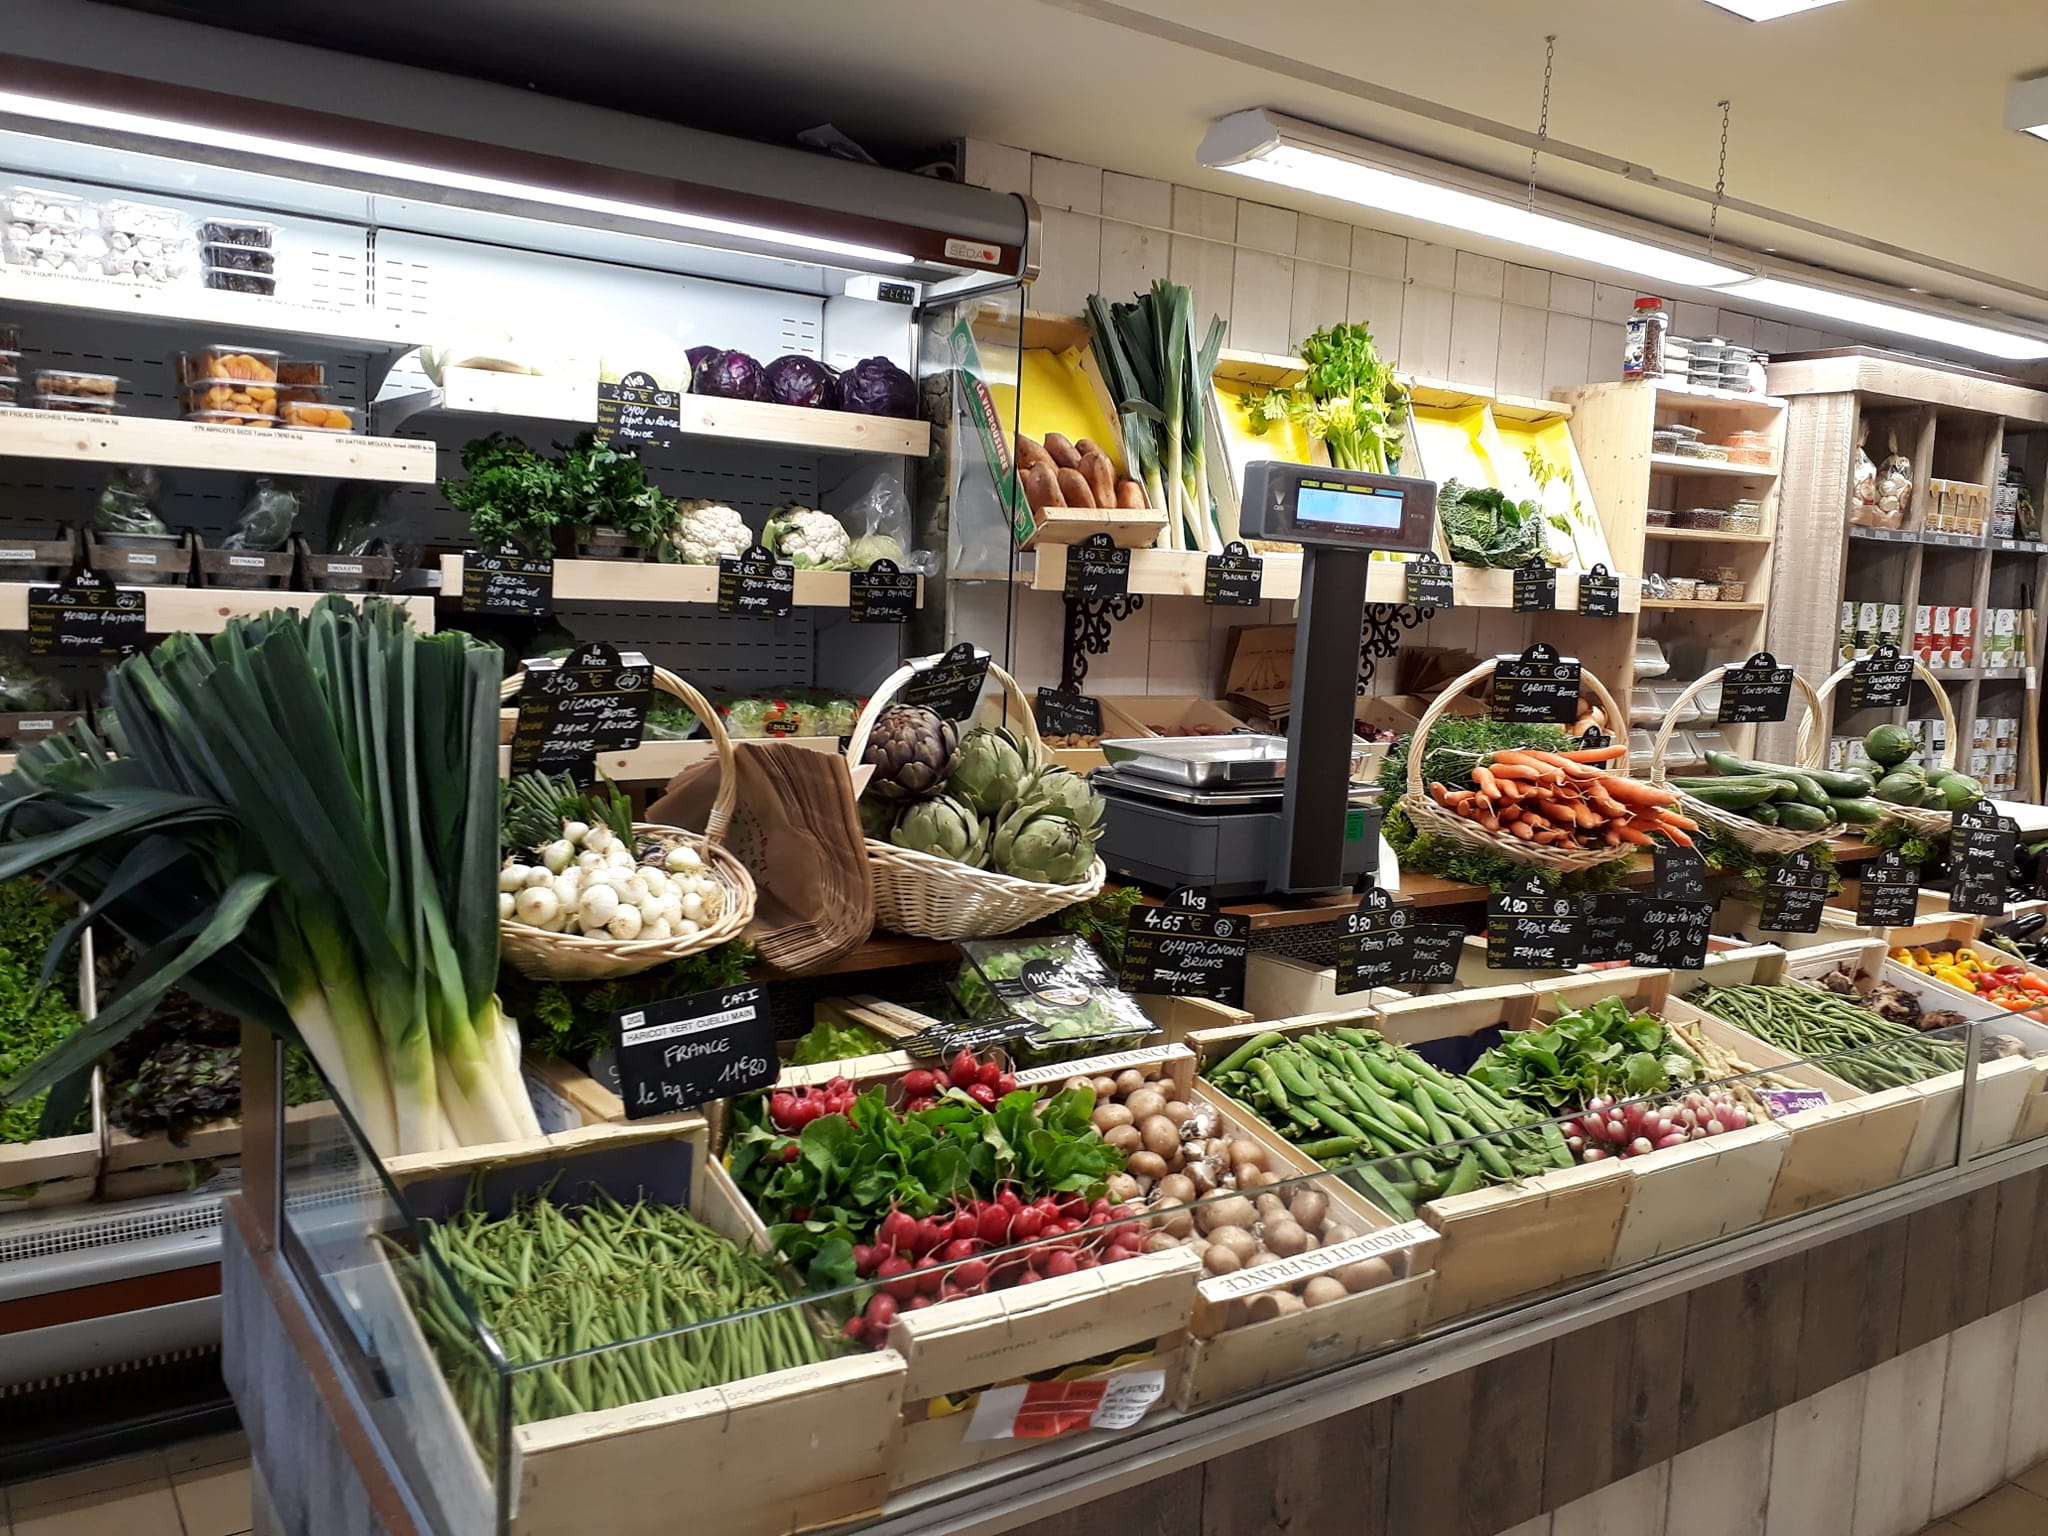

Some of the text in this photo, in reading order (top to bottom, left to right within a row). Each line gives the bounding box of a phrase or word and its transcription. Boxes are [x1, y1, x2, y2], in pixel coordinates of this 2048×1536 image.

[582, 654, 607, 666] Pièce
[542, 739, 595, 753] FRANCE
[1968, 847, 1996, 858] FRANCE
[1181, 890, 1207, 910] 1kg
[1368, 891, 1386, 908] 1kg
[1160, 940, 1246, 956] CHAMPIGNONS
[1513, 947, 1555, 959] FRANCE
[1180, 954, 1224, 968] BRUNS
[1153, 968, 1206, 986] FRANCE
[627, 1015, 642, 1025] 202
[627, 1008, 753, 1042] HARICOT VERT CUEILLI MAIN
[664, 1037, 731, 1068] FRANCE
[1014, 1062, 1081, 1083] RODUIT
[1220, 1227, 1416, 1292] PRODUIT EN FRANCE
